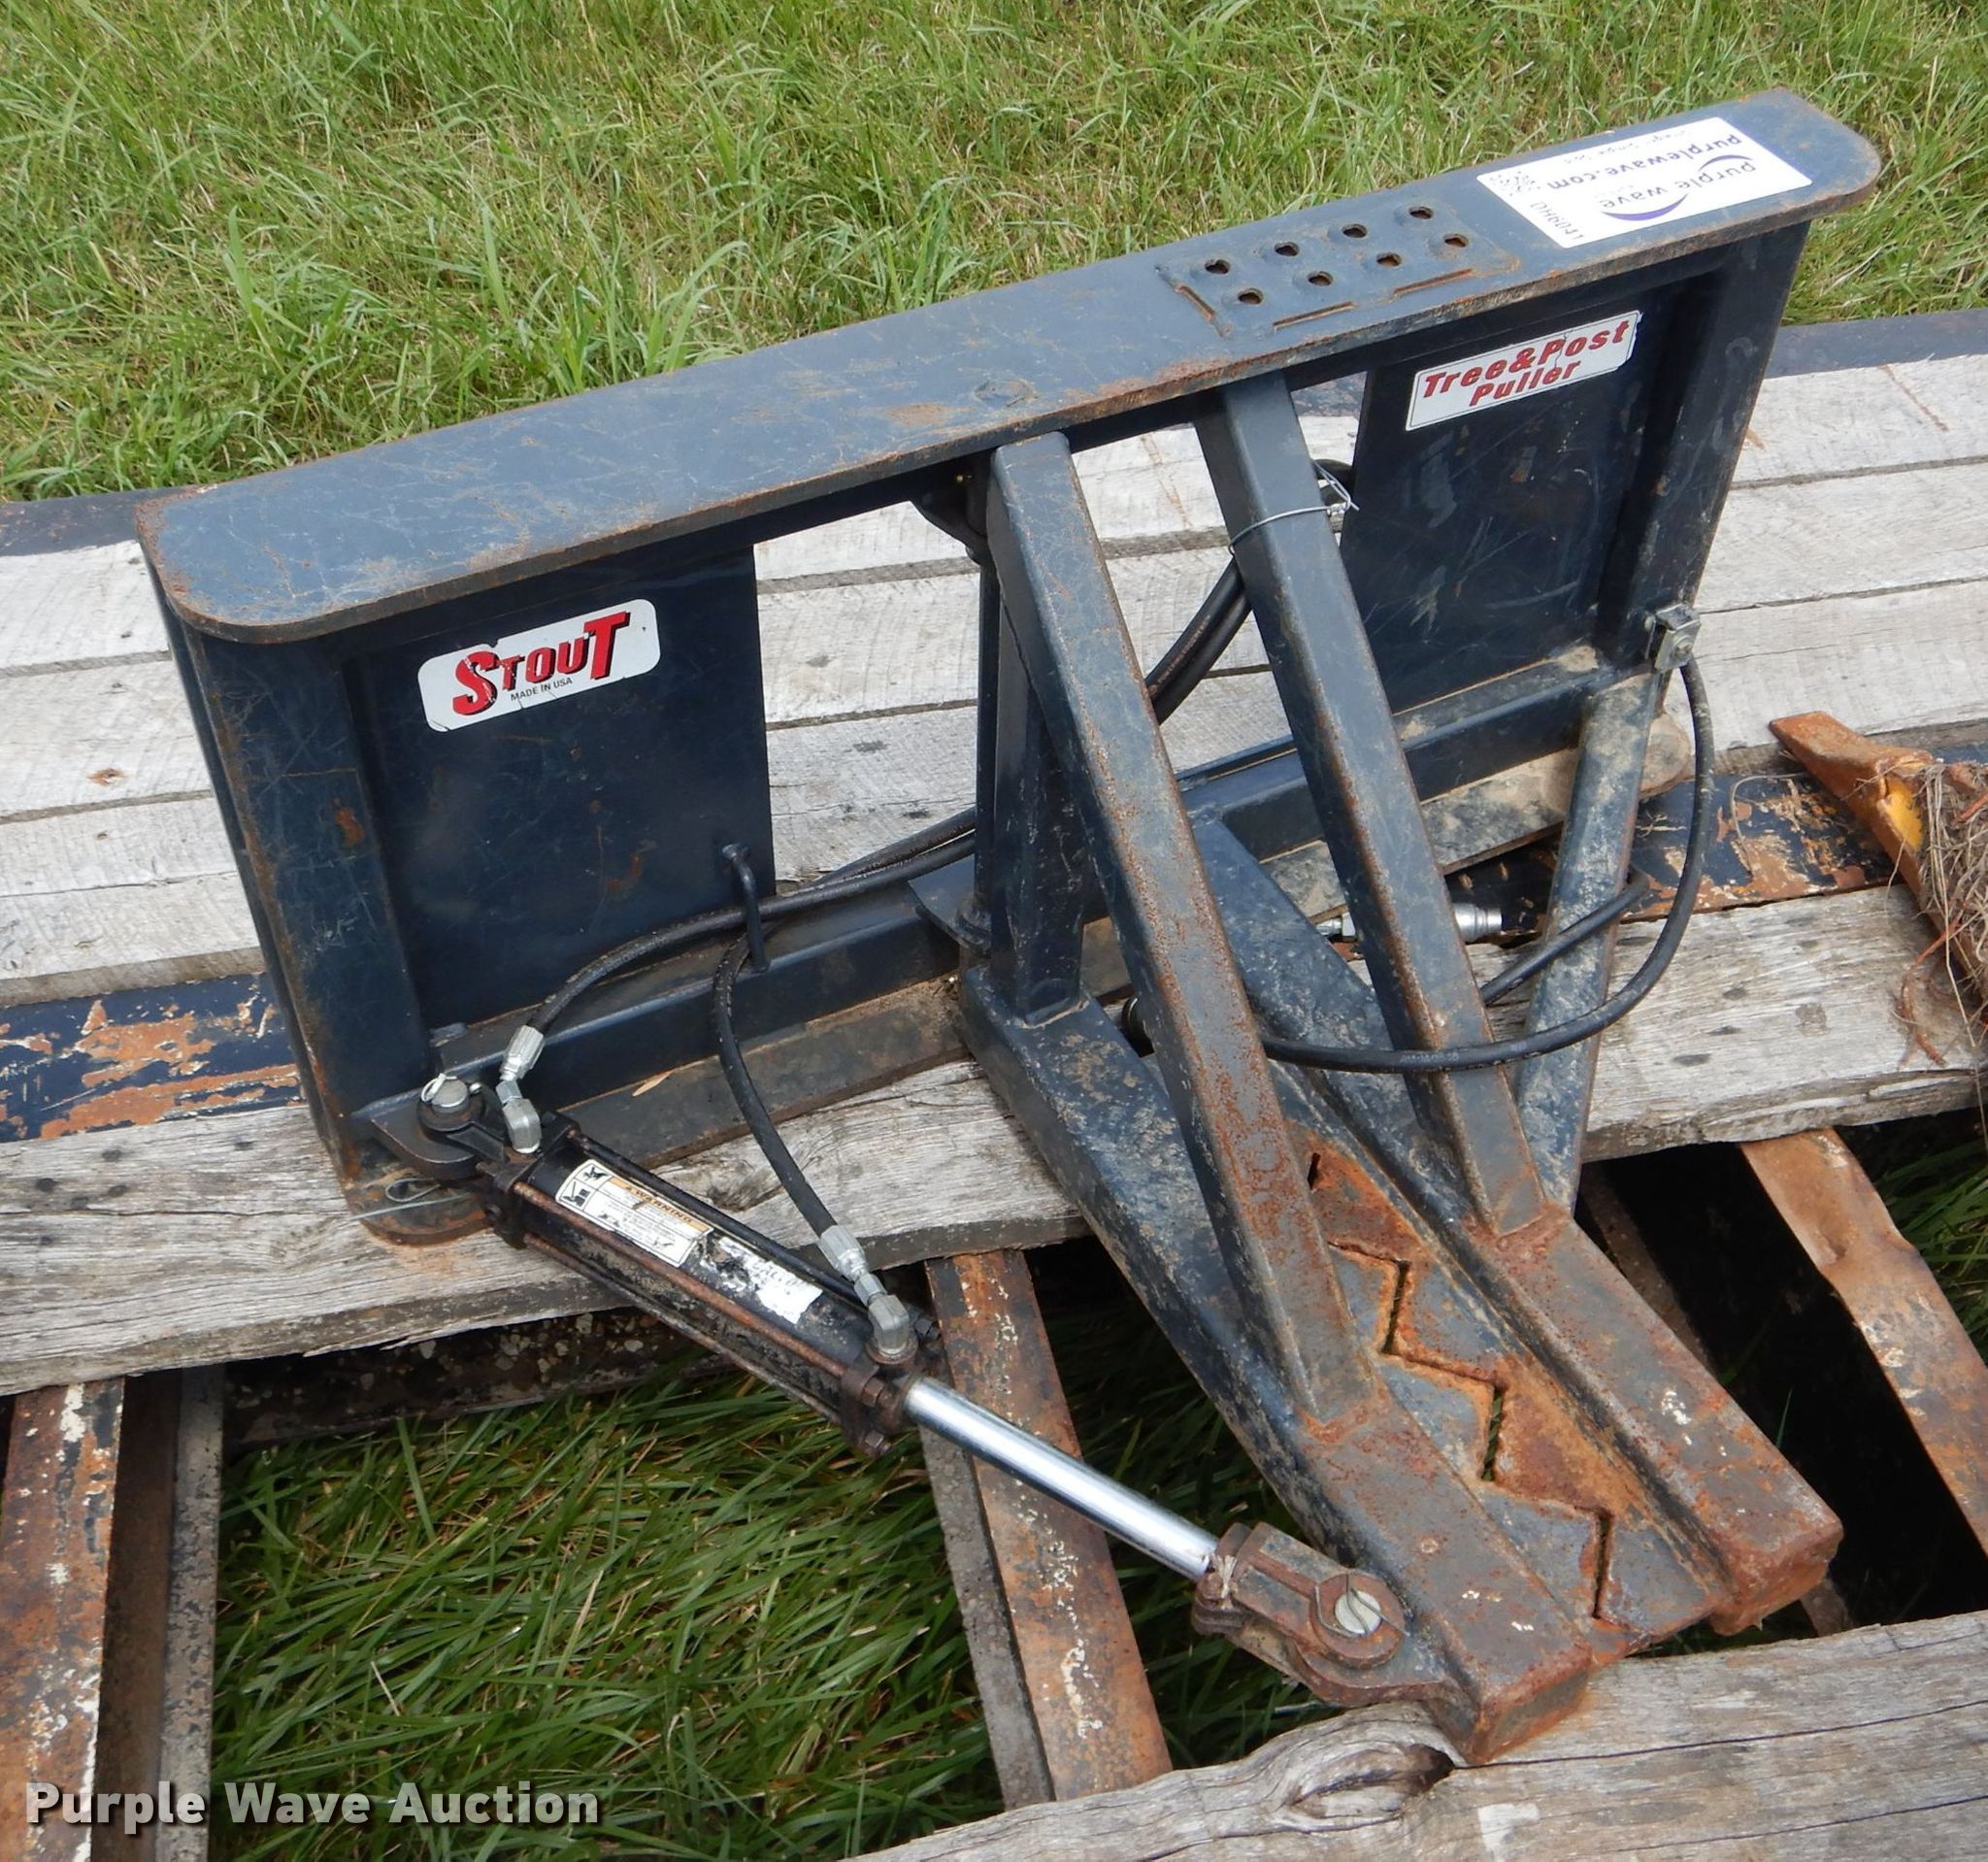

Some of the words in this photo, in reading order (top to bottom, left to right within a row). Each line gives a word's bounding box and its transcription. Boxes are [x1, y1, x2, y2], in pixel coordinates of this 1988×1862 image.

[1547, 134, 1743, 190] purplewave.com
[1674, 160, 1756, 191] purple
[1600, 184, 1668, 210] wave
[1423, 320, 1629, 398] Tree&Post
[1469, 360, 1581, 407] Puller
[510, 686, 539, 702] MADE
[540, 682, 551, 693] IN
[552, 677, 573, 689] USA
[635, 1189, 693, 1223] WARNING
